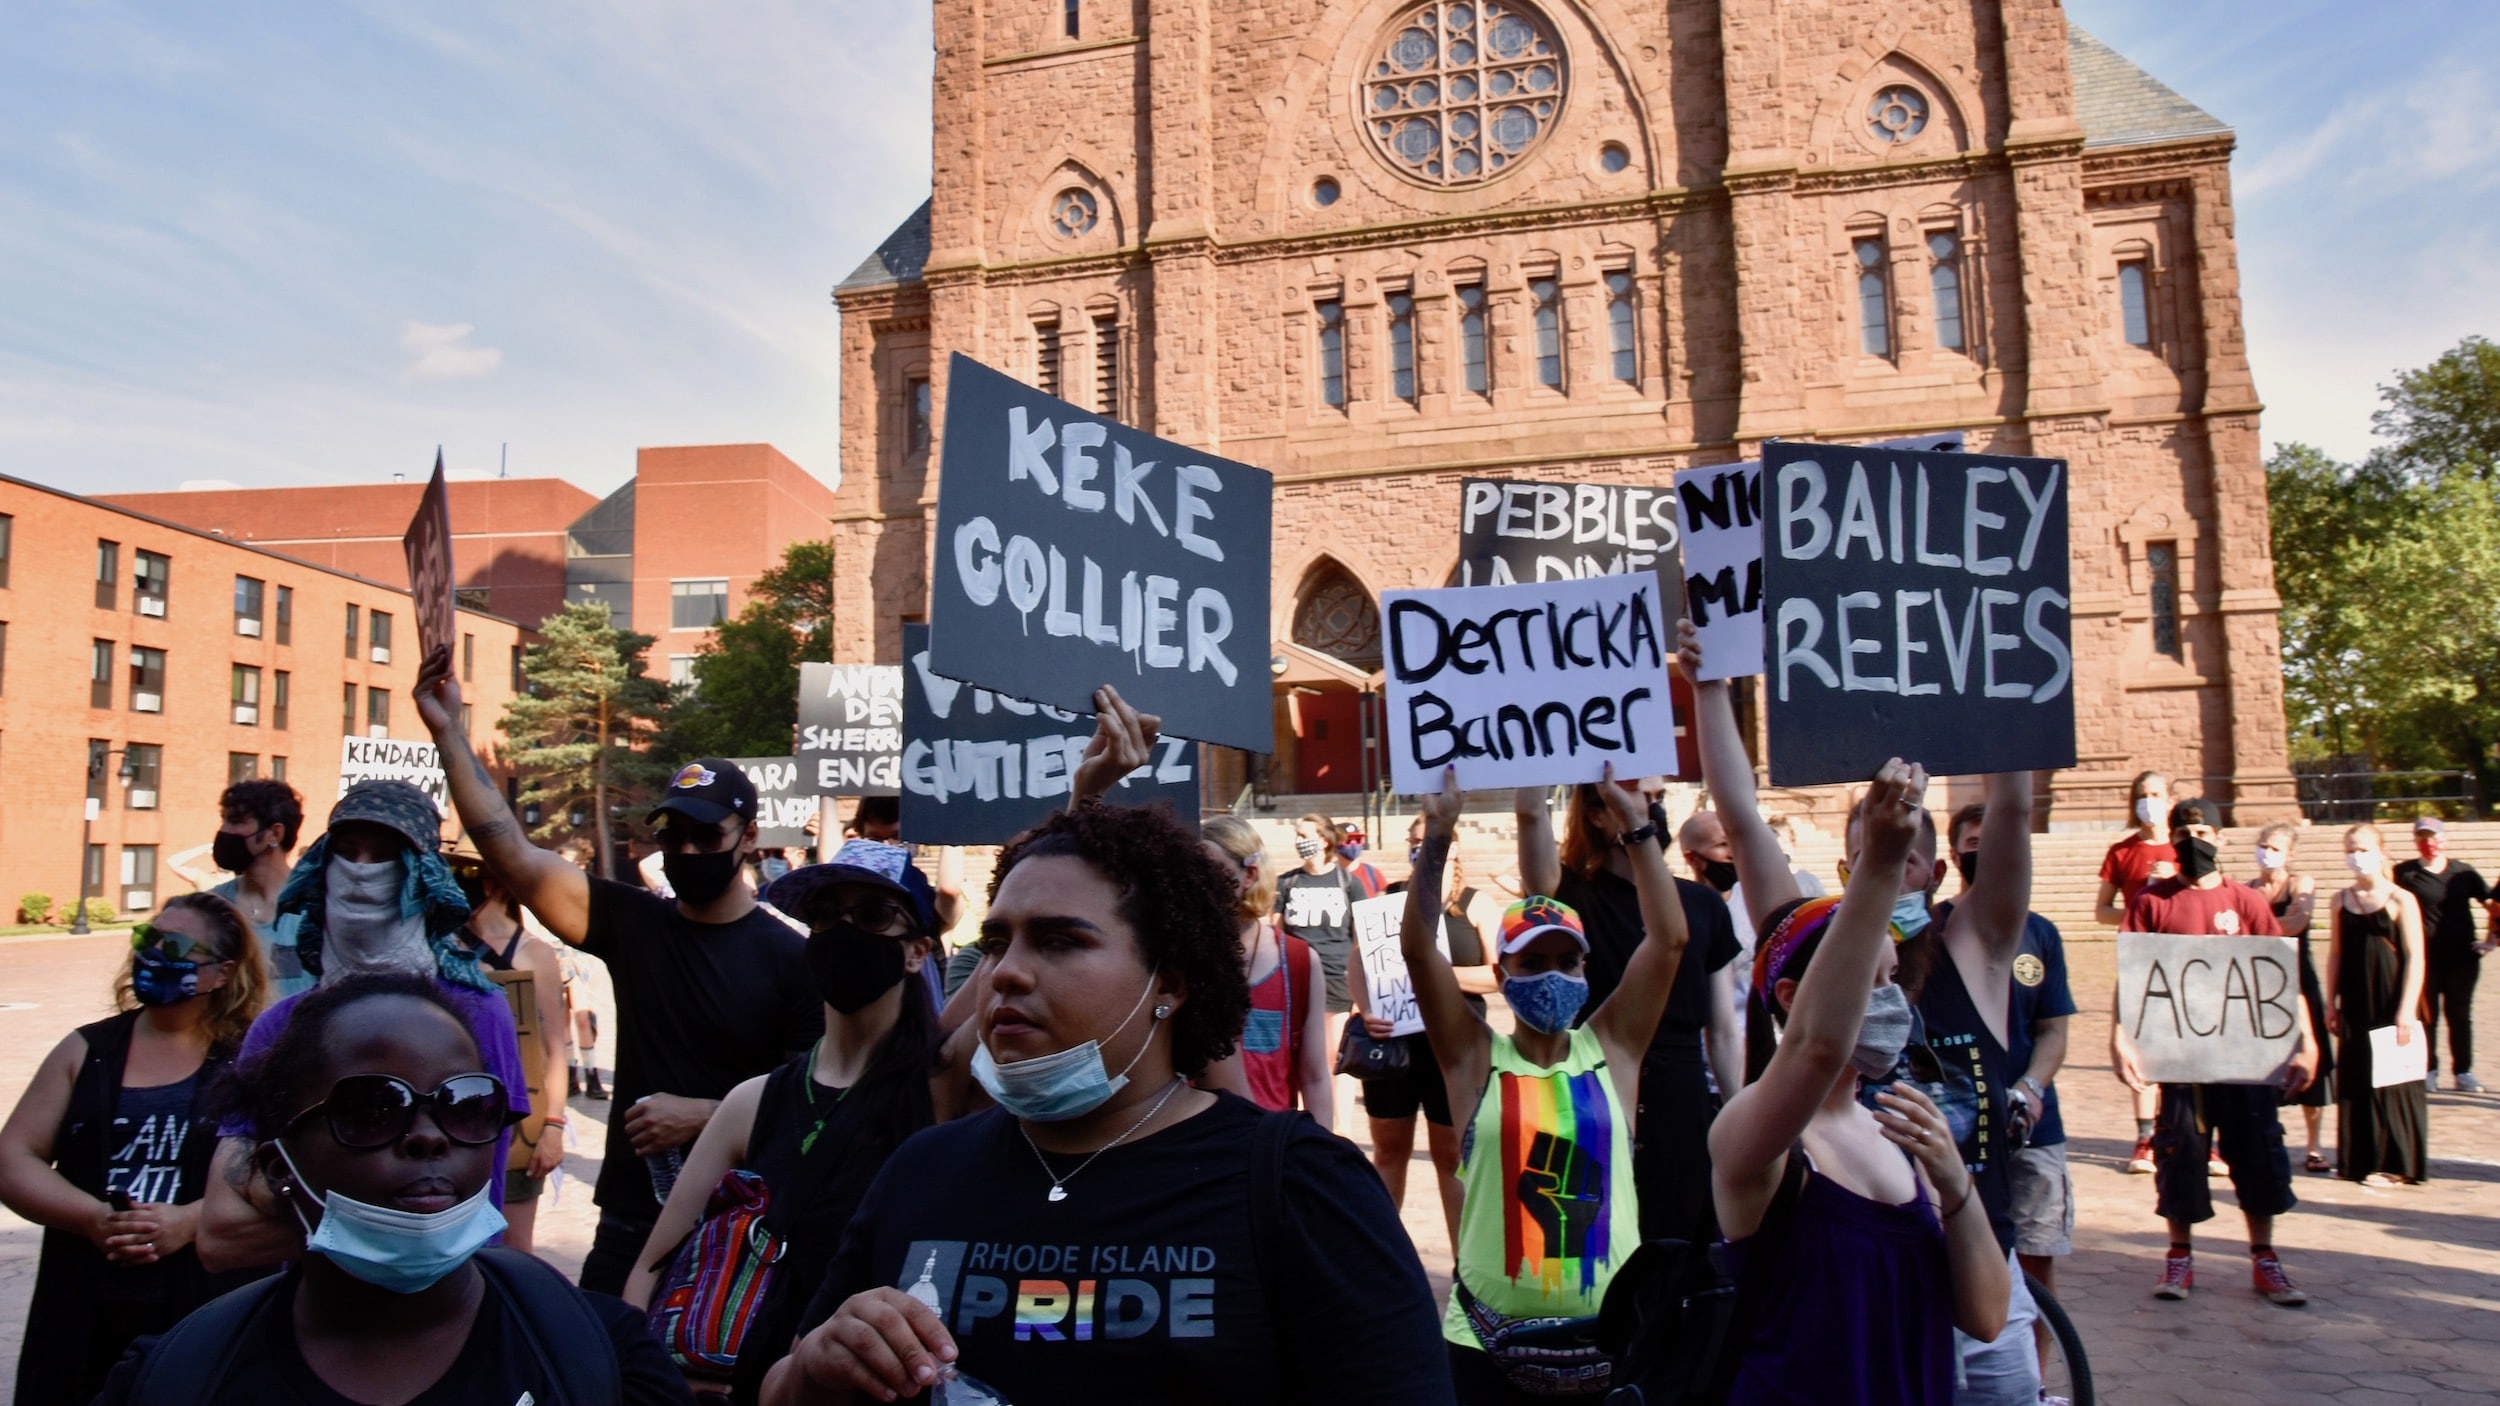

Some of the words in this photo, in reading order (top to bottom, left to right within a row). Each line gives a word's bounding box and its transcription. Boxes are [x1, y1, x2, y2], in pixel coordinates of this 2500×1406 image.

[1008, 406, 1224, 561] KEKE
[1464, 482, 1679, 553] PEBBLES
[1777, 459, 2059, 576] BAILEY
[954, 515, 1238, 687] COLLIER
[1777, 586, 2072, 704] REEVES
[1409, 687, 1651, 769] Banner
[2134, 956, 2295, 1040] ACAB
[968, 1242, 1079, 1273] RHODE
[1091, 1245, 1216, 1273] ISLAND
[956, 1275, 1216, 1341] PRIDE
